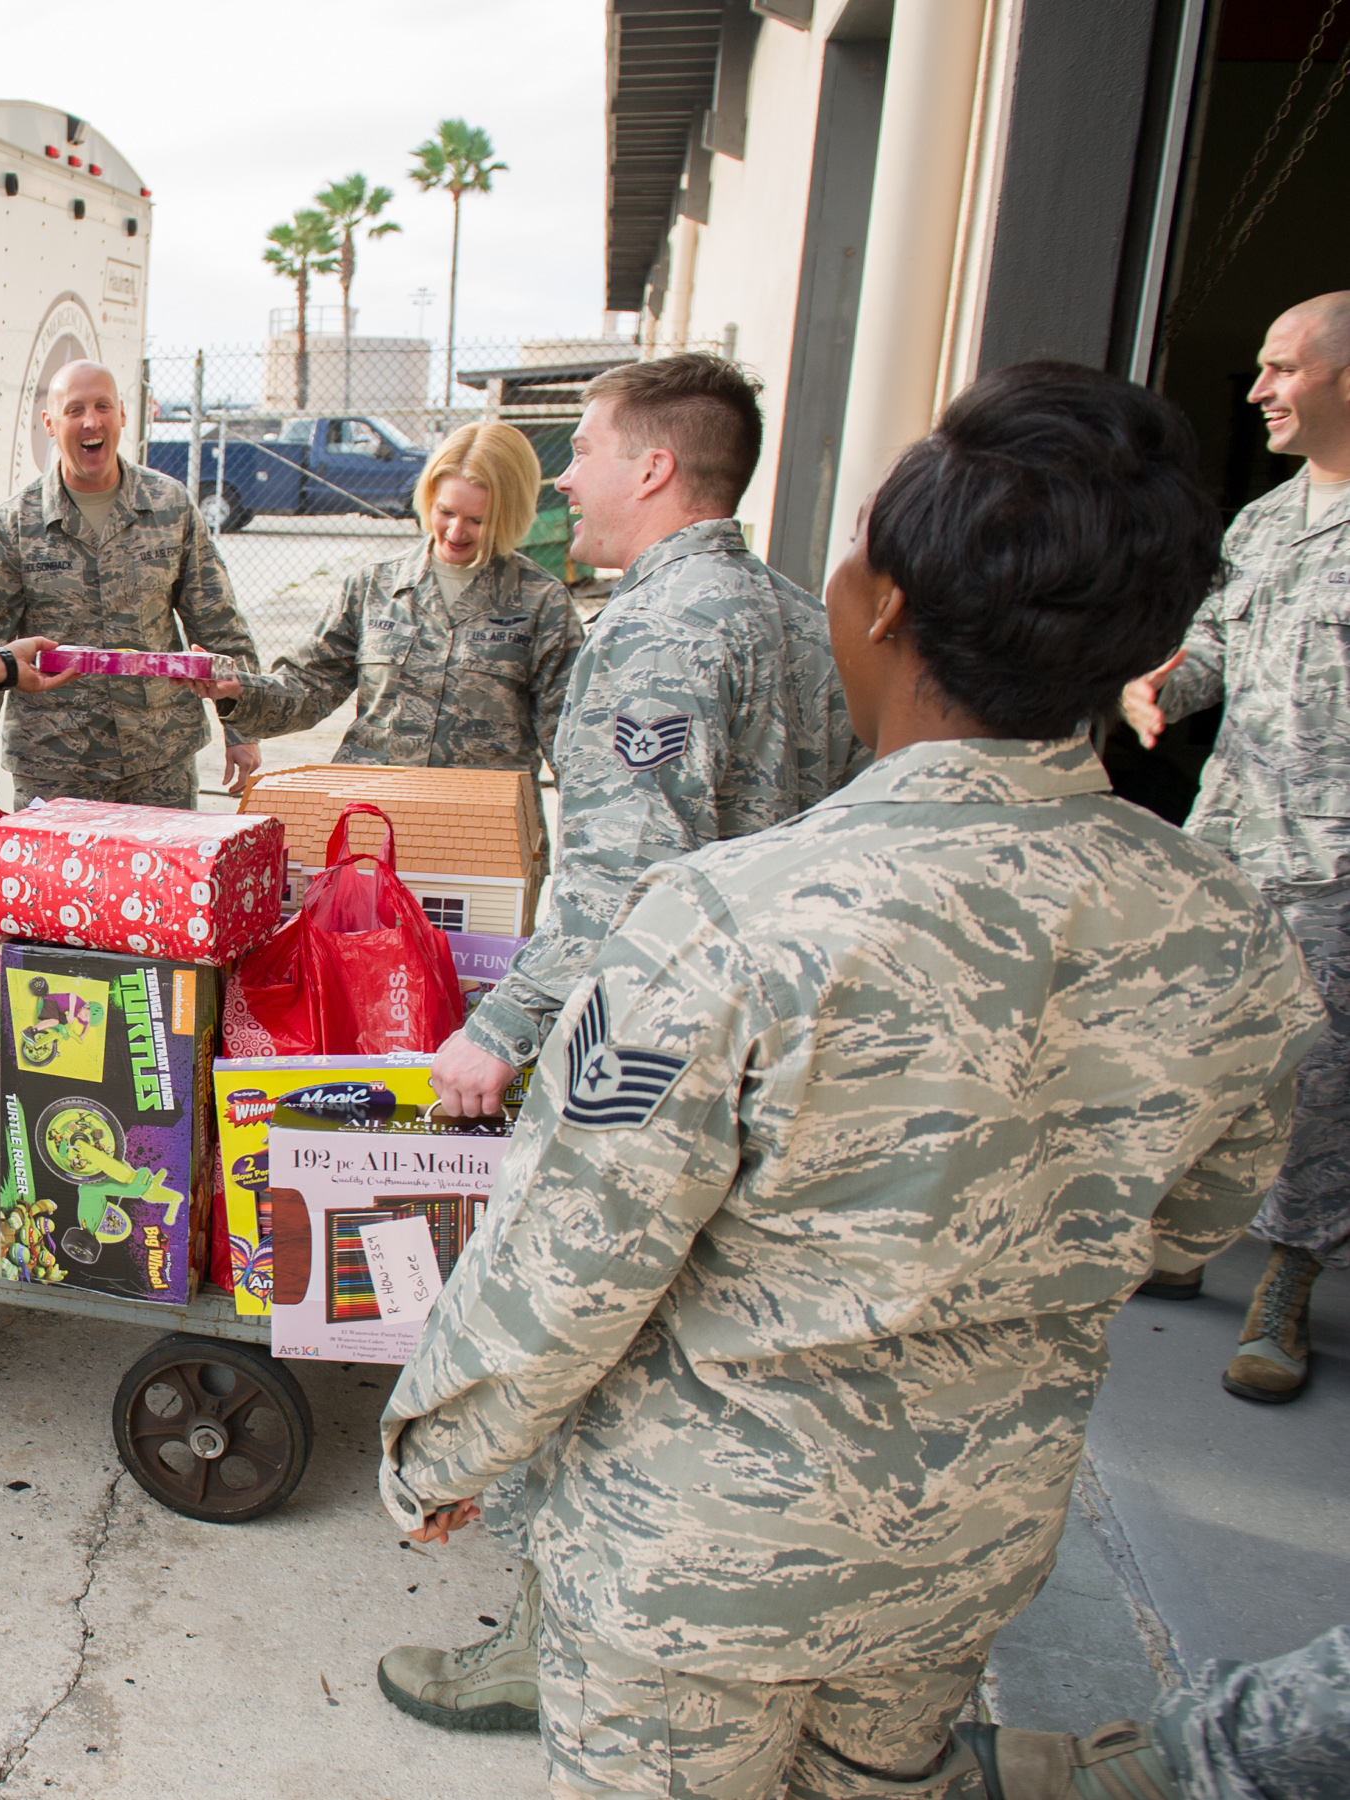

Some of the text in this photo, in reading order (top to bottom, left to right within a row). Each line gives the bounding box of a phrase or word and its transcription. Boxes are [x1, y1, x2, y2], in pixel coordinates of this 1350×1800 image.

[368, 619, 395, 632] BAKER
[473, 953, 508, 970] FUN
[174, 974, 185, 1030] nickelodeon
[385, 964, 410, 1038] Less.
[120, 968, 163, 1112] TURTLES
[146, 967, 175, 1111] TEENAGE MUTANT NINJA
[504, 1088, 527, 1101] Lik
[235, 1102, 276, 1121] WHAM
[5, 1093, 29, 1195] TURTLE RACER
[244, 1156, 256, 1172] 2
[291, 1148, 331, 1170] 192
[336, 1159, 354, 1173] pc
[232, 1173, 253, 1182] Blow
[331, 1175, 364, 1186] Quality
[366, 1176, 430, 1188] Craftsmanship
[142, 1226, 169, 1290] Big Wheel
[407, 1254, 429, 1302] Bailee
